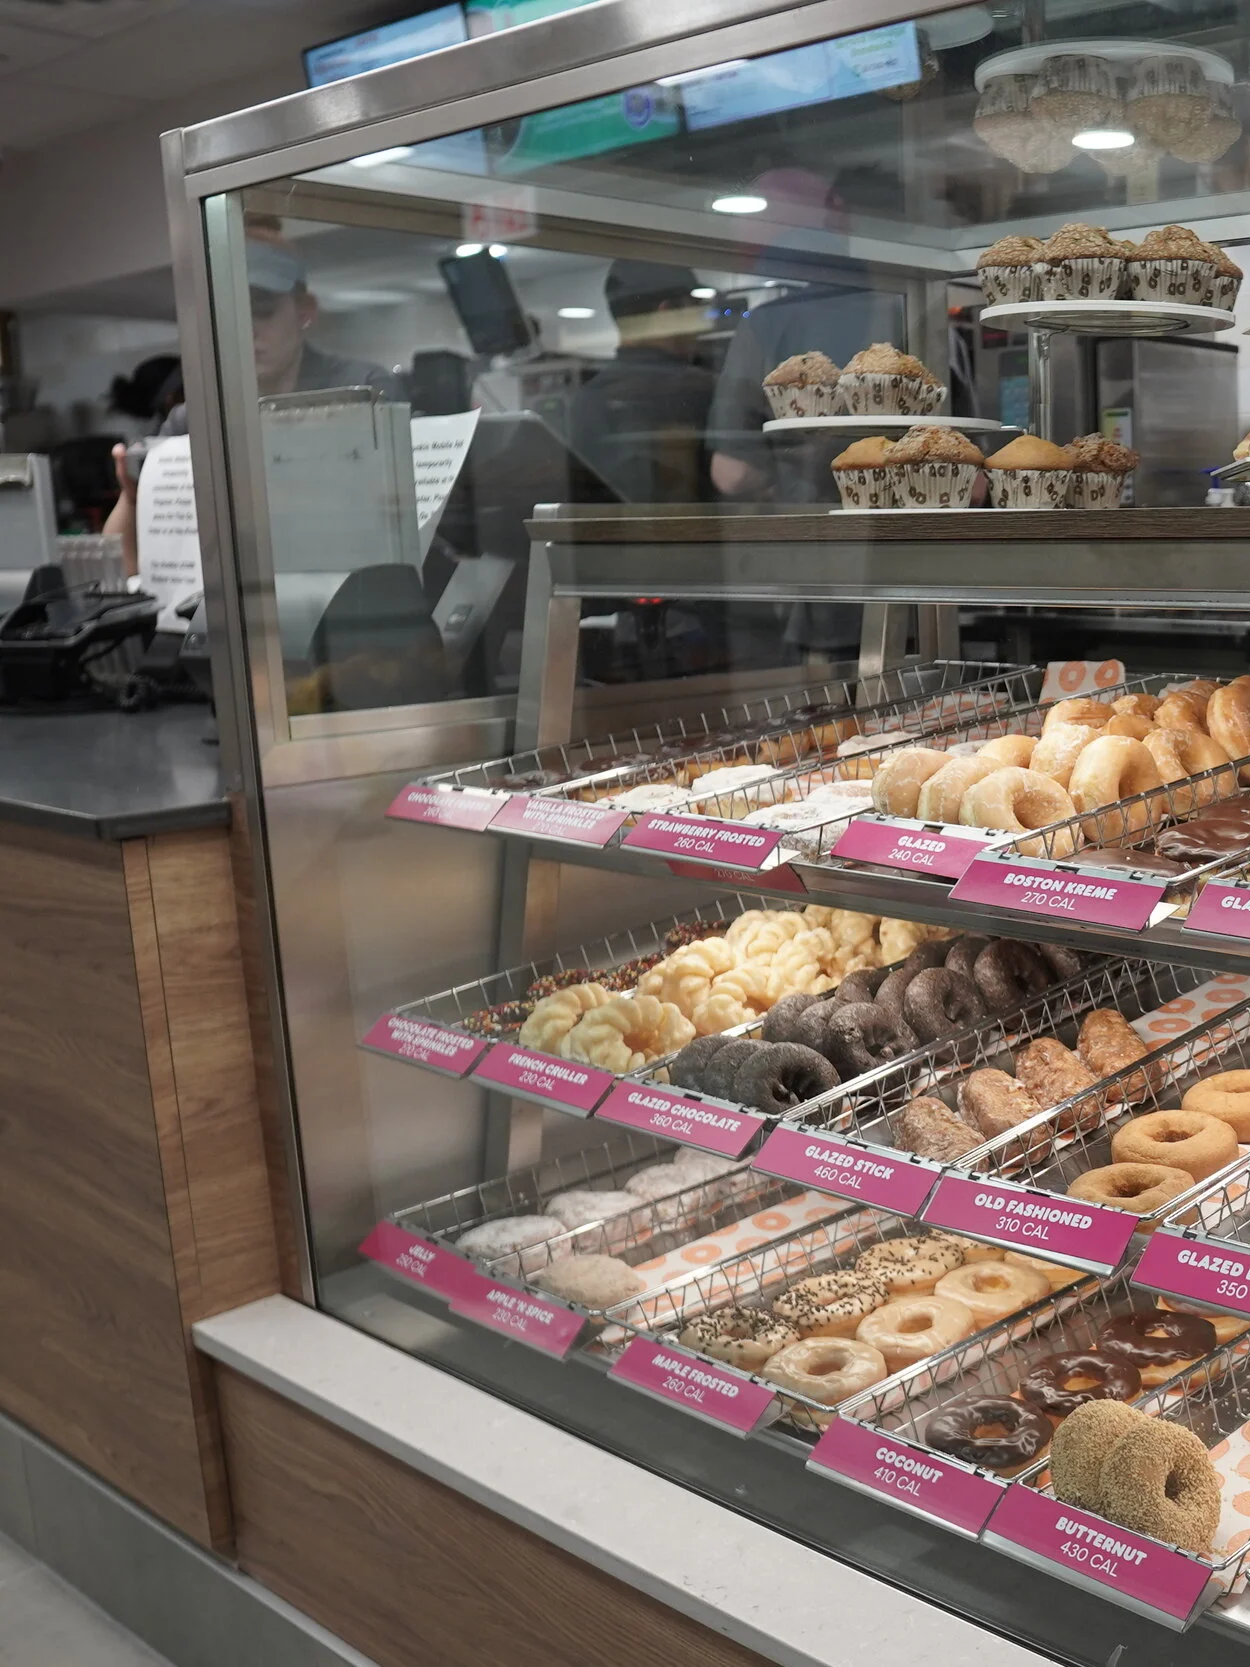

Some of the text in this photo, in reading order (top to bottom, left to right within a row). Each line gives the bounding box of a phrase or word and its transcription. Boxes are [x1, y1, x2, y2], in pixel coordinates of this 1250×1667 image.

[523, 809, 547, 821] WITH
[564, 804, 605, 820] FROSTED
[648, 818, 766, 848] STRAWBERRY FROSTED
[673, 836, 714, 853] 260 CAL
[897, 835, 946, 853] GLAZED
[887, 848, 934, 866] 240 CAL
[1003, 872, 1118, 900] BOSTON KREME
[1020, 891, 1075, 911] 270 CAL
[387, 1017, 475, 1050] CHOCOLATE FROSTED
[391, 1028, 414, 1043] WITH
[508, 1052, 589, 1086] FRENCH CRULLER
[537, 1075, 557, 1091] CAL
[627, 1091, 742, 1132] GLAZED CHOCOLATE
[649, 1112, 693, 1135] 360 CAL
[804, 1145, 895, 1181] GLAZED STICK
[813, 1164, 862, 1189] 460 CAL
[974, 1193, 1093, 1230] OLD FASHIONED
[995, 1216, 1049, 1240] 310 CAL
[408, 1243, 437, 1262] JELLY
[1177, 1249, 1244, 1277] GLAZED
[410, 1259, 429, 1278] CAL
[1216, 1280, 1248, 1300] 350
[486, 1289, 515, 1309] APPLE
[524, 1304, 555, 1325] SPICE
[508, 1313, 529, 1331] CAL
[651, 1353, 740, 1398] MAPLE FROSTED
[662, 1375, 705, 1404] 260 CAL
[875, 1446, 944, 1484] COCONUT
[873, 1466, 921, 1497] 410 CAL
[1054, 1515, 1148, 1567] BUTTERNUT
[1059, 1540, 1118, 1578] 430 CAL
